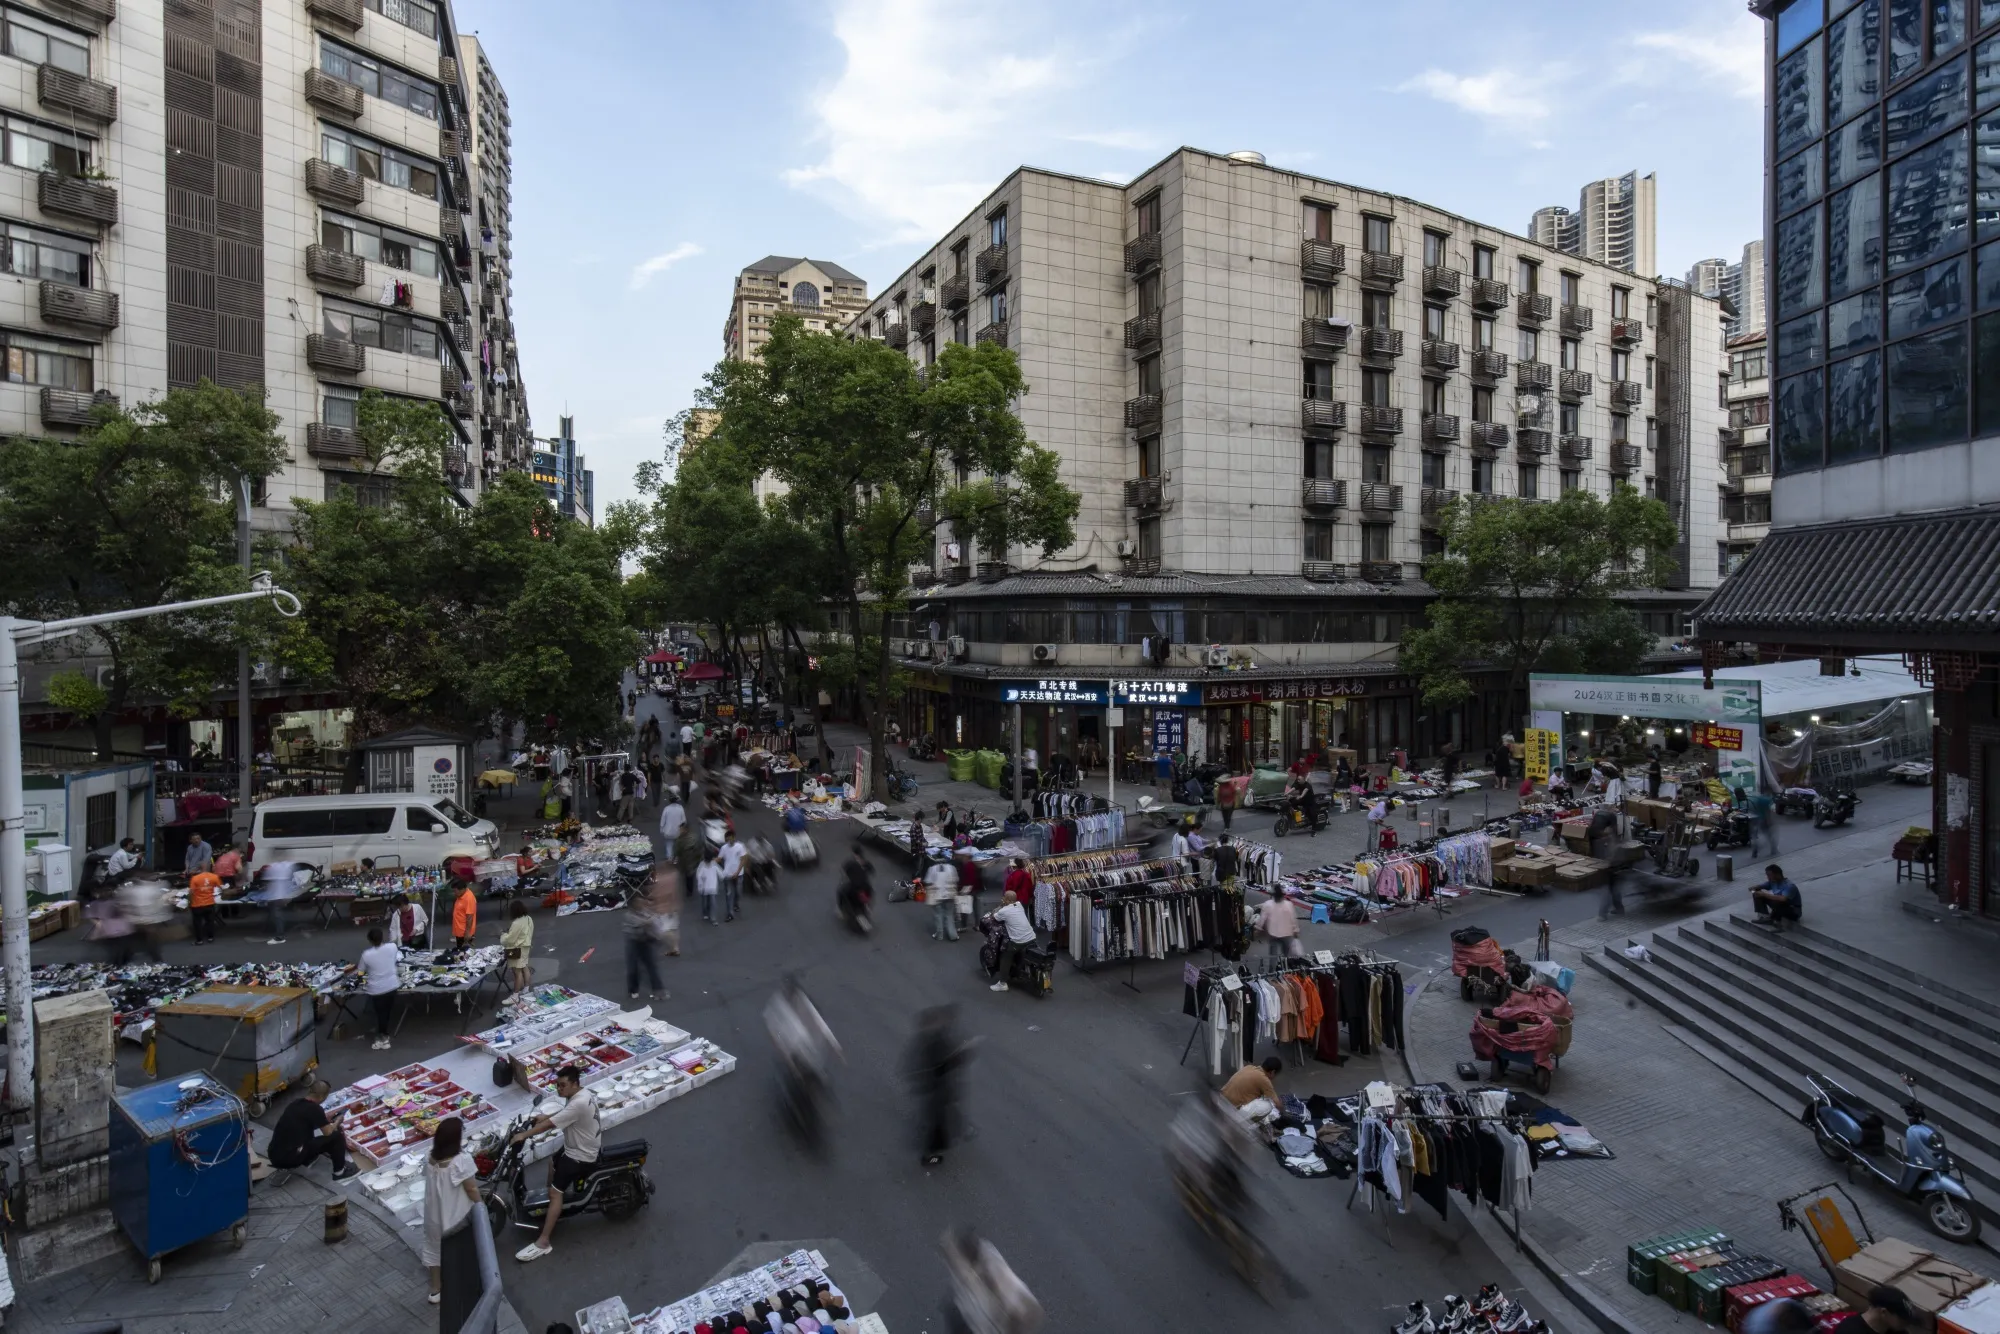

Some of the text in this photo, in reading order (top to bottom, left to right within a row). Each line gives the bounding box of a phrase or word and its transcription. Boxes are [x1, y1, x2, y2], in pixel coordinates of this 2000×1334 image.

[1039, 680, 1077, 690] 西北专线
[1268, 678, 1366, 699] 湖南特色米粉
[1020, 690, 1062, 701] 天天达物流
[1064, 692, 1077, 701] 武汉
[1084, 692, 1097, 701] 西安
[1128, 694, 1177, 703] 武汉 郑州
[1155, 711, 1171, 721] 武汉
[1157, 722, 1181, 733] 兰州
[1708, 727, 1740, 738] 图书专区
[1157, 734, 1182, 745] 银川
